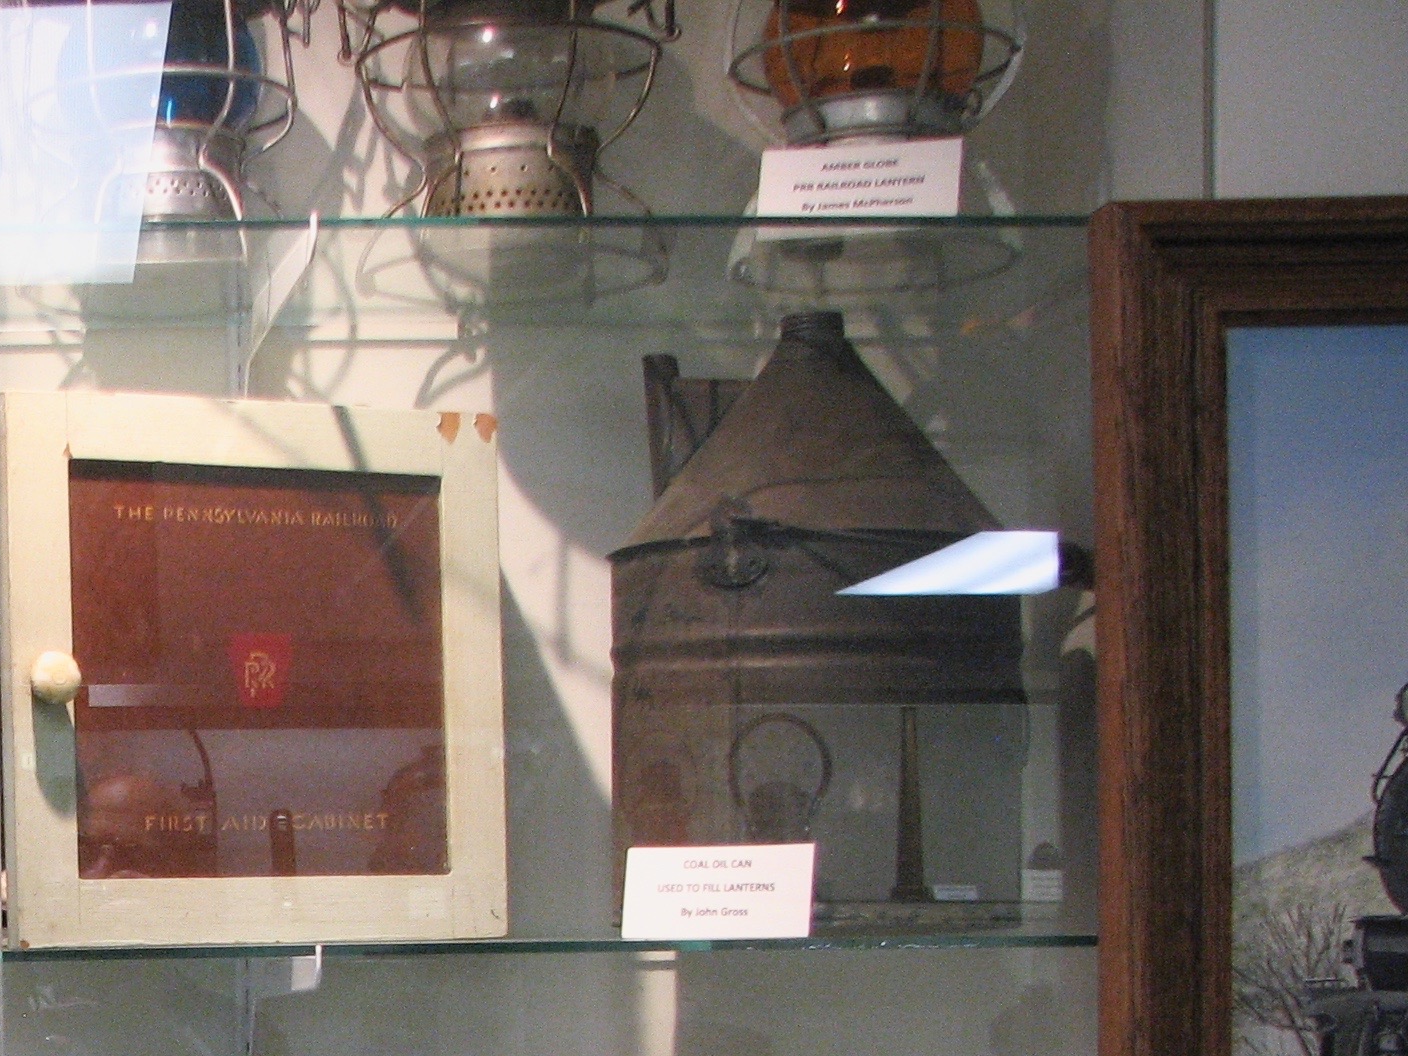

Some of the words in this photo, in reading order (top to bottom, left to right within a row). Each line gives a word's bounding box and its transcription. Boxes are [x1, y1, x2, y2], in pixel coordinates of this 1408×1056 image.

[817, 178, 873, 191] RAILROAD
[874, 174, 926, 188] LANTERN
[801, 202, 815, 213] By
[817, 200, 850, 211] James
[113, 504, 154, 521] THE
[163, 506, 305, 527] PENNSYLVANIA
[310, 511, 398, 529] RAILROD
[144, 815, 206, 833] FIRST
[221, 815, 267, 832] AID
[292, 813, 390, 831] CABINET
[683, 859, 709, 869] COAL
[712, 859, 728, 869] OIL
[731, 859, 752, 869] CAN
[657, 883, 684, 893] USED
[686, 883, 700, 893] TO
[703, 883, 721, 893] FILL
[723, 883, 776, 893] LANTERNS
[681, 908, 692, 918] By
[696, 908, 718, 917] John
[721, 908, 749, 917] Gross
